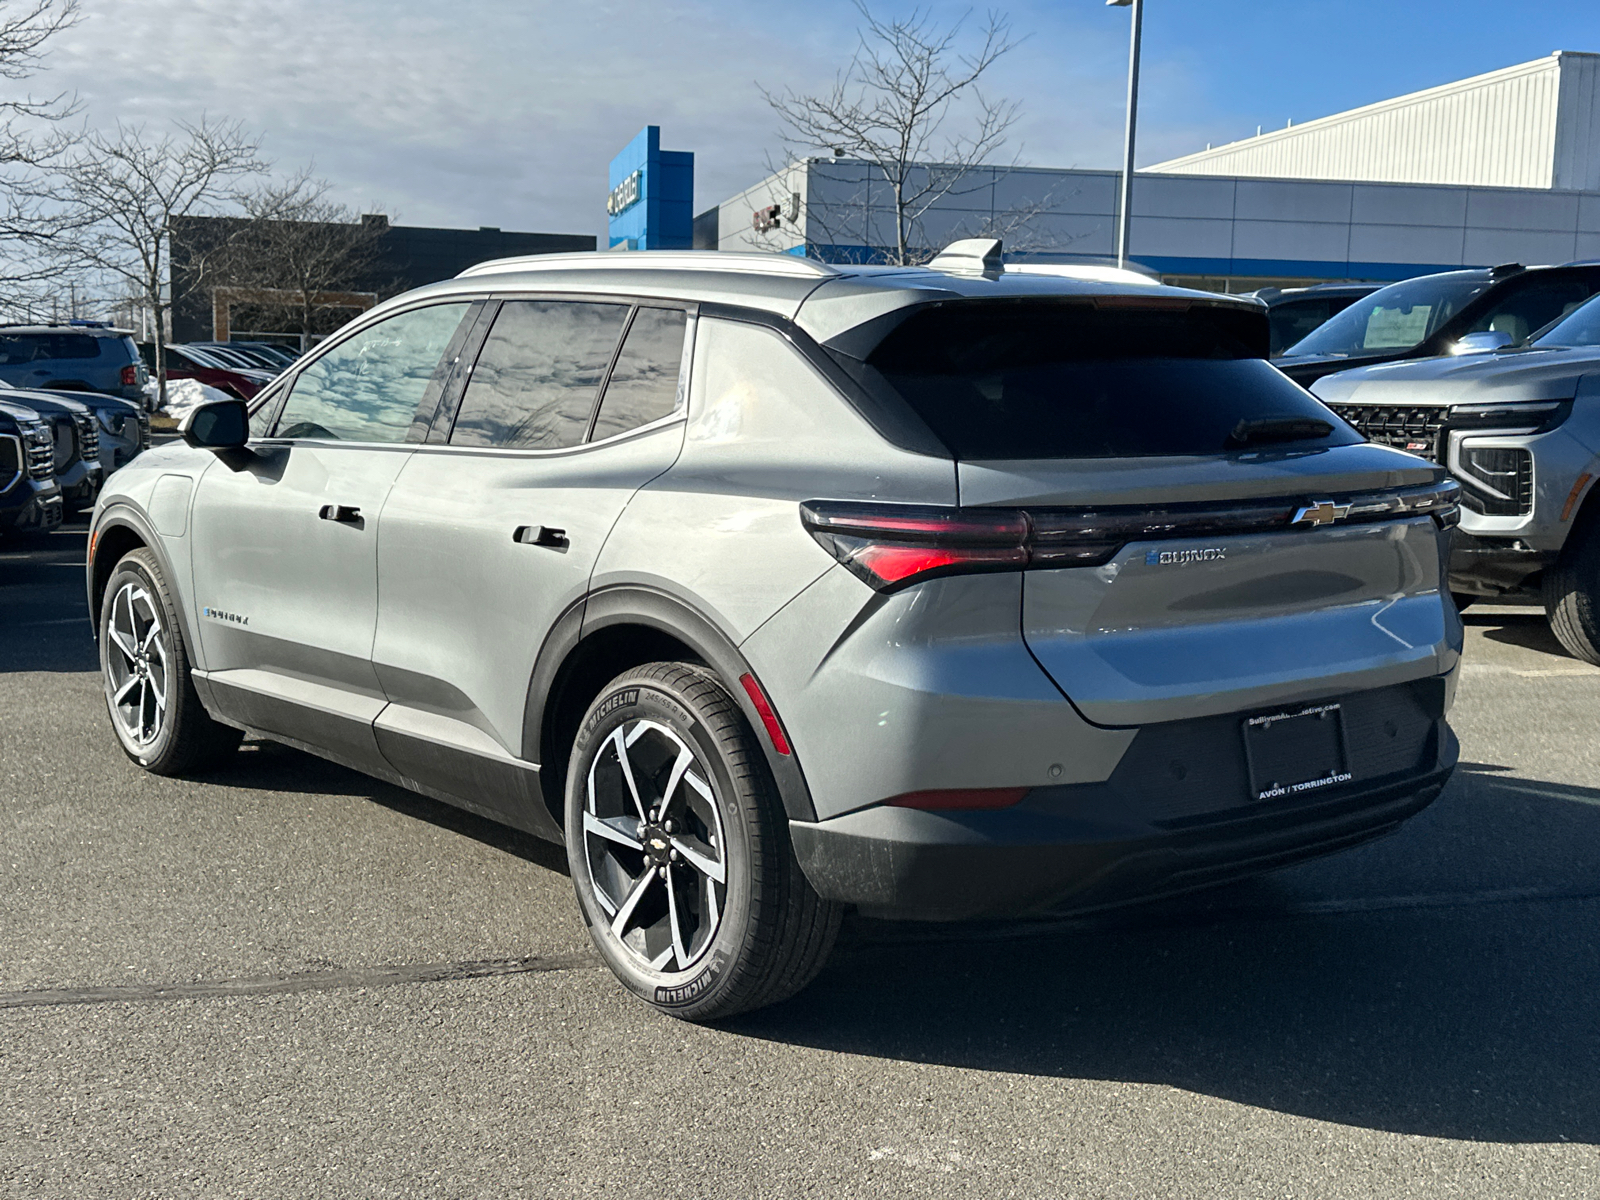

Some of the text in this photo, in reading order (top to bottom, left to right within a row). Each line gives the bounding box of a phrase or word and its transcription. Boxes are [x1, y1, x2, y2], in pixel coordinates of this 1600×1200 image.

[589, 690, 638, 731] MICHELIN
[645, 692, 688, 721] 245/55 R 19
[1259, 788, 1285, 799] AVON
[1292, 773, 1352, 792] TORRINGTON
[656, 970, 713, 1003] MICHELIN
